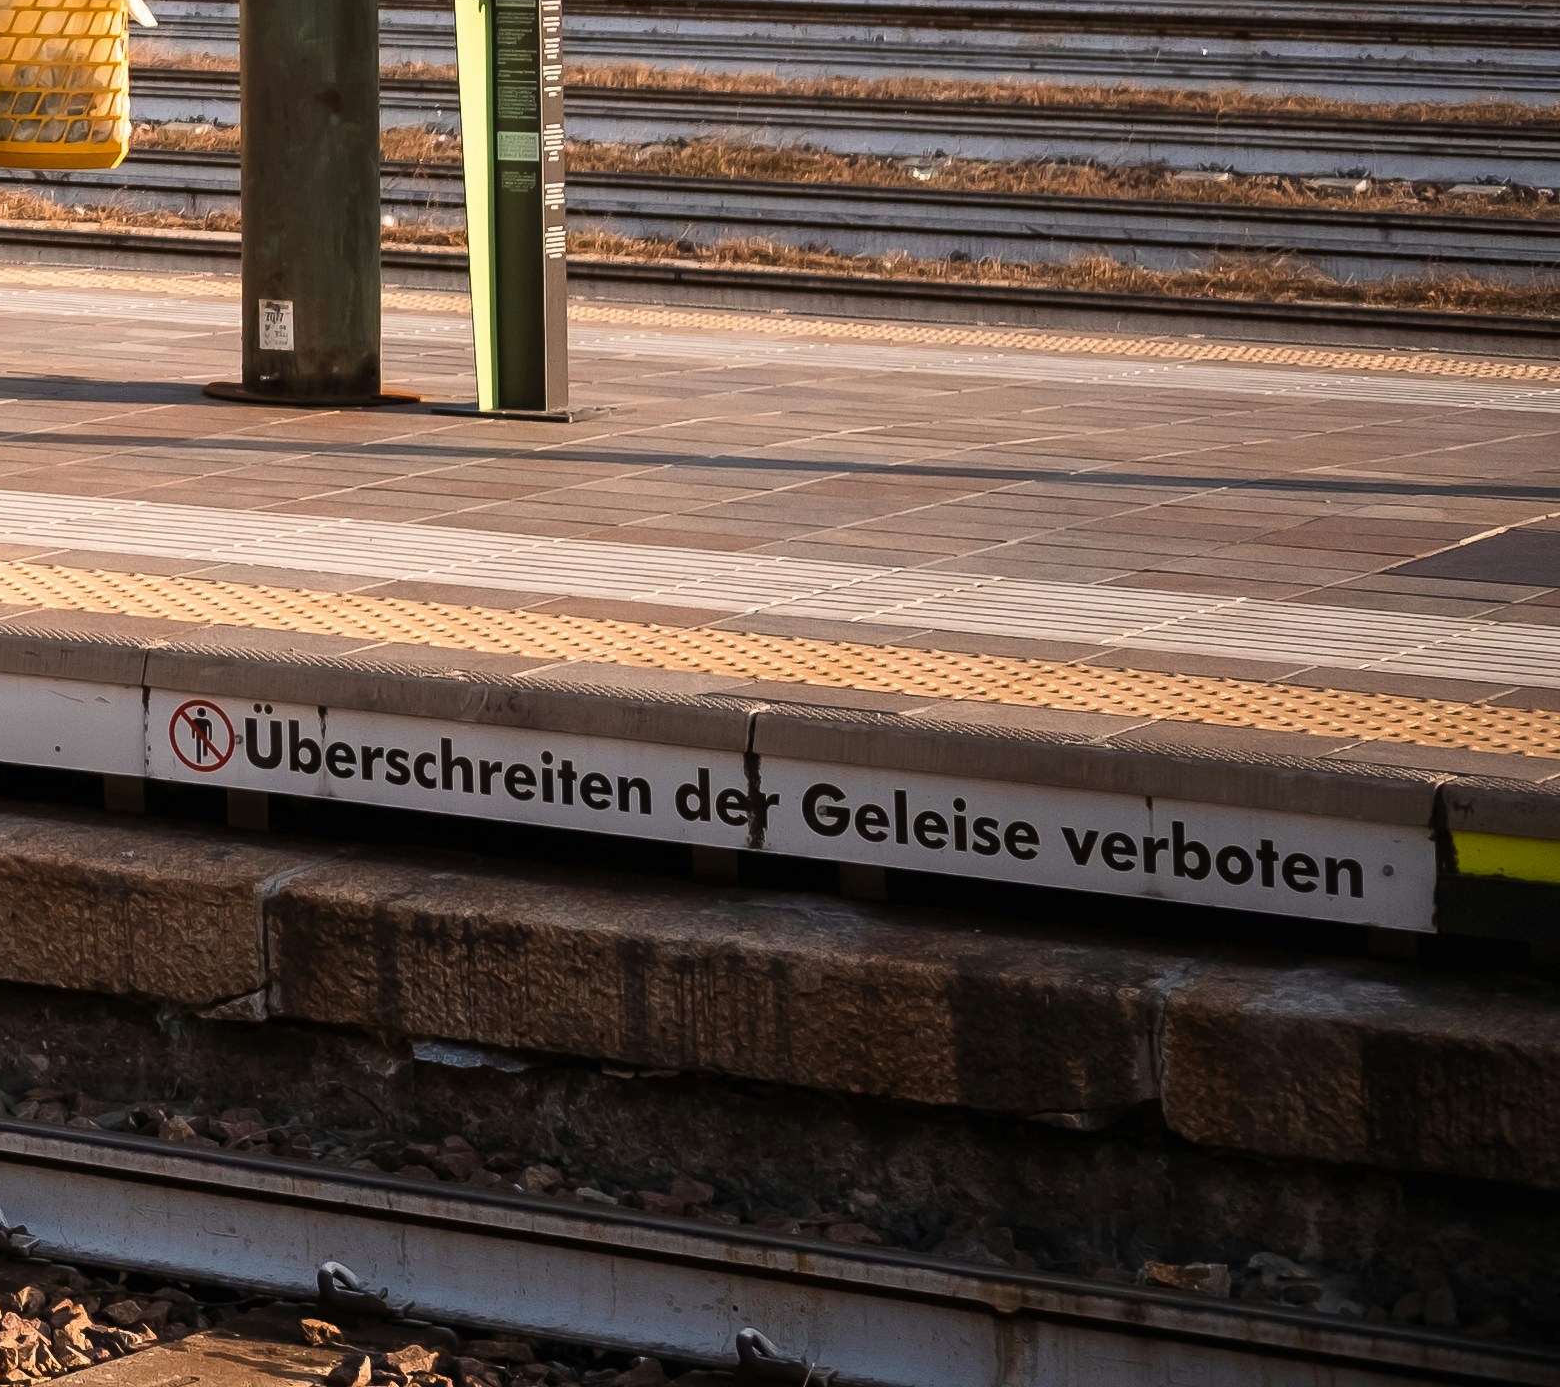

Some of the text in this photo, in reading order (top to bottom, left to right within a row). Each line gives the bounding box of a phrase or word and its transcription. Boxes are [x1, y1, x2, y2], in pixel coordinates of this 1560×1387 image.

[244, 703, 1365, 899] Überschreiten der Geleise verboten
